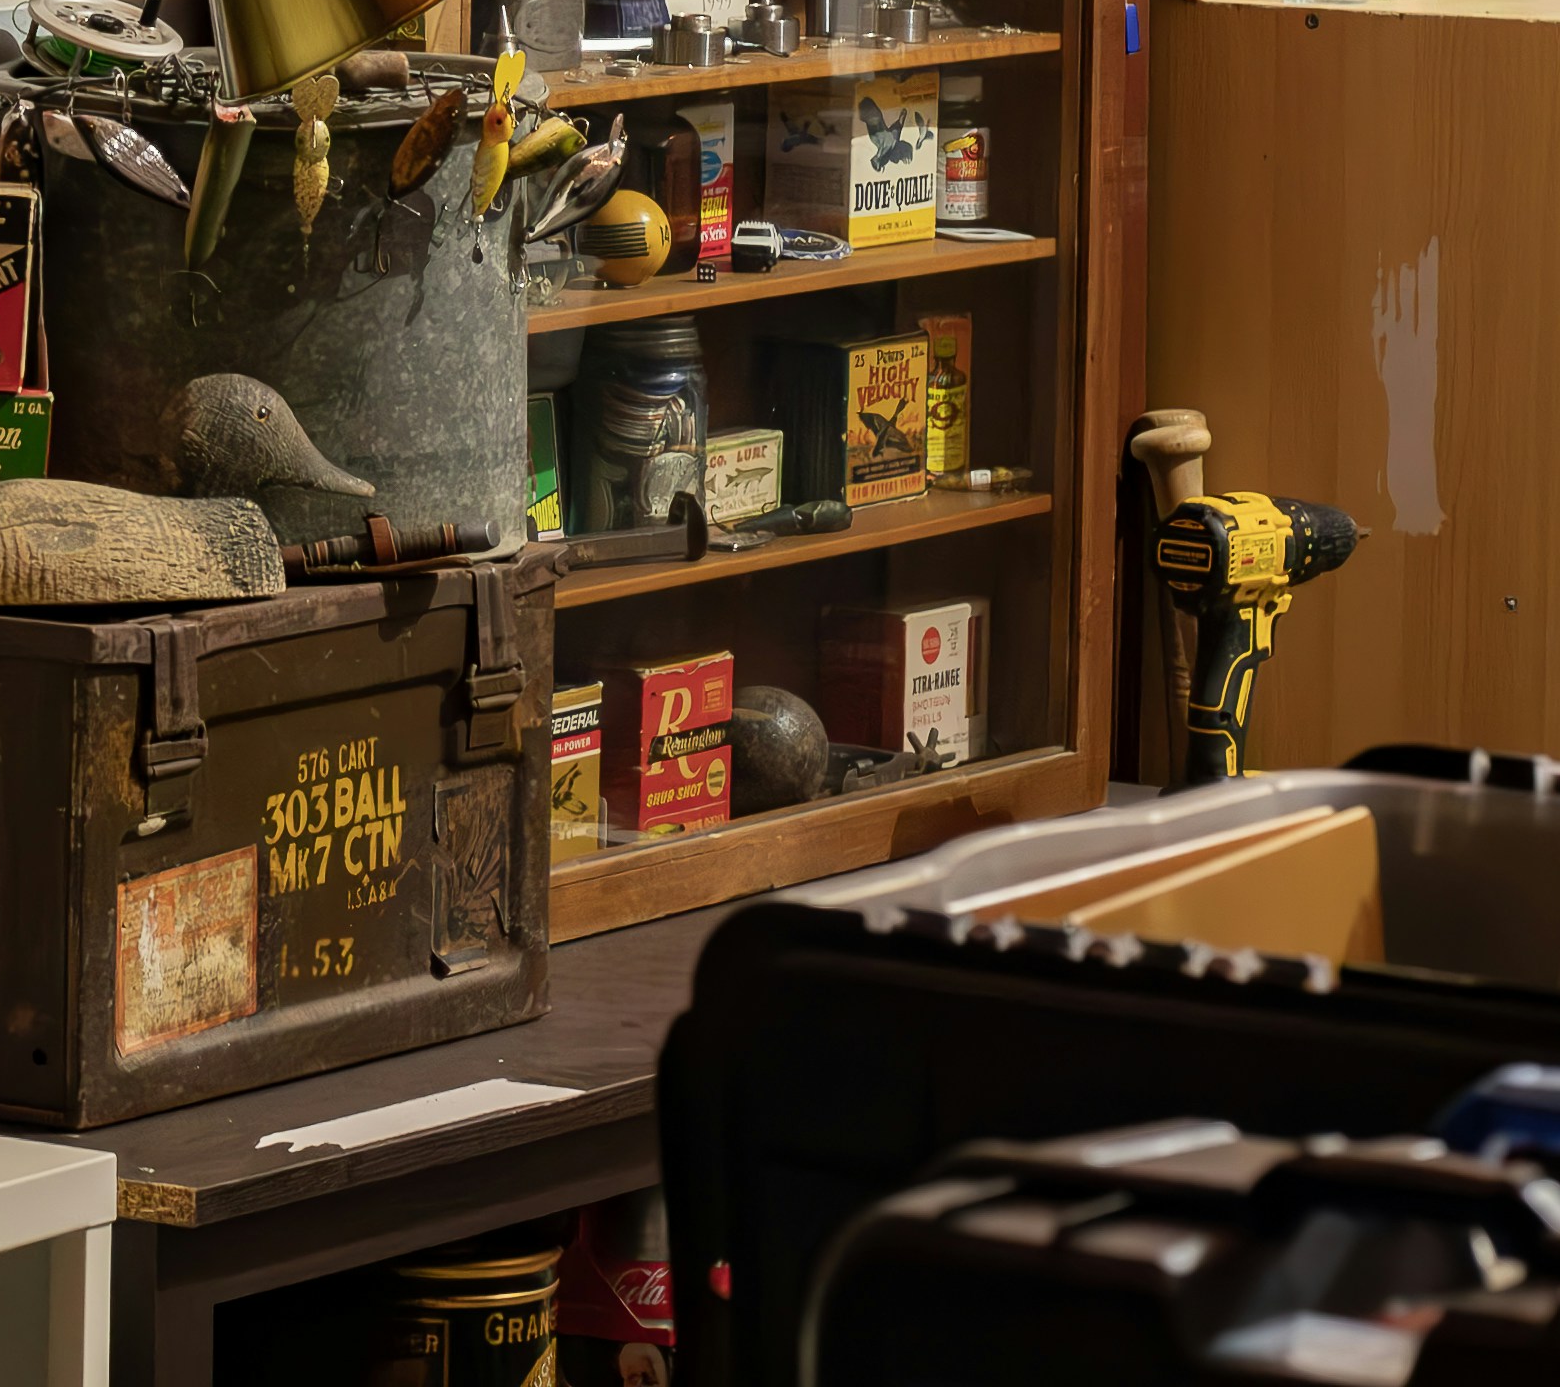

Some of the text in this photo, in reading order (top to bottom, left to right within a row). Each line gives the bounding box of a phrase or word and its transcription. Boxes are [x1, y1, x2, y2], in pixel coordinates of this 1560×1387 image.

[853, 179, 890, 212] DOVE
[854, 353, 867, 369] 25
[868, 358, 911, 386] HIGH
[13, 401, 26, 416] 12
[27, 402, 46, 417] GA.
[856, 375, 921, 411] VELOCITY
[911, 667, 962, 696] XTRA-RANGE
[552, 736, 592, 753] HI-POWER
[645, 686, 704, 779] R
[661, 726, 726, 759] Remington
[296, 735, 379, 785] 576 CART
[334, 764, 407, 829] BALL
[676, 781, 705, 802] SHOT
[313, 834, 334, 886] 7
[343, 815, 404, 878] CTN
